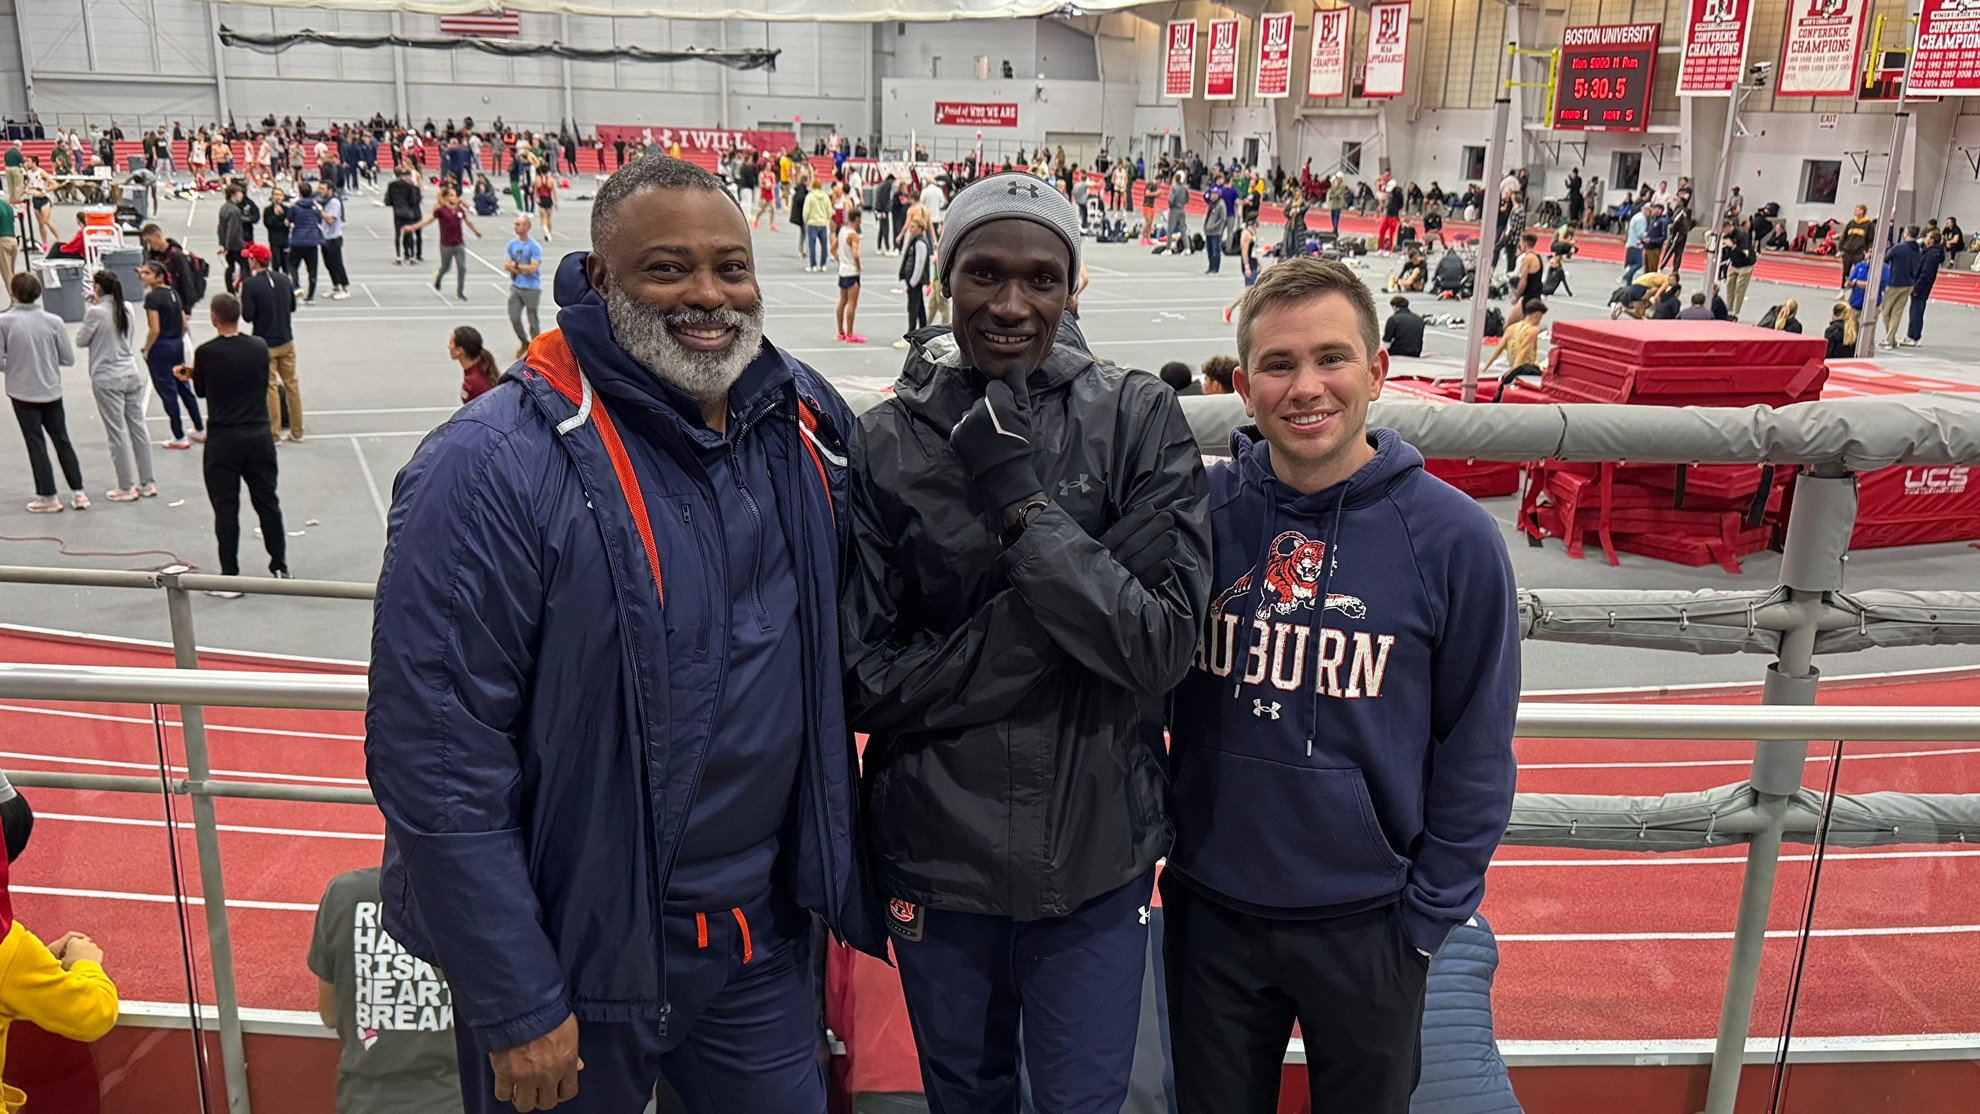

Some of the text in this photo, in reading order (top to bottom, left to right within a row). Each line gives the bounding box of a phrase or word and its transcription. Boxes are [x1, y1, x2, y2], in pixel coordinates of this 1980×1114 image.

[1564, 25, 1655, 45] BOSTON UNIVERSITY
[1694, 30, 1738, 43] CONFERENCE
[1798, 27, 1849, 38] CONFERENCE
[1688, 42, 1740, 57] CHAMPIONS
[1791, 39, 1851, 53] CHAMPIONS
[1622, 56, 1639, 68] Run
[1574, 77, 1627, 99] 5:30.5
[944, 105, 961, 116] Proud
[986, 106, 999, 117] WE
[1000, 107, 1016, 118] ARE
[1583, 109, 1588, 121] 1
[1625, 109, 1634, 121] 5
[1820, 114, 1837, 123] EXIT
[679, 130, 690, 148] I
[1904, 467, 1970, 488] UCS
[355, 954, 437, 980] RISK
